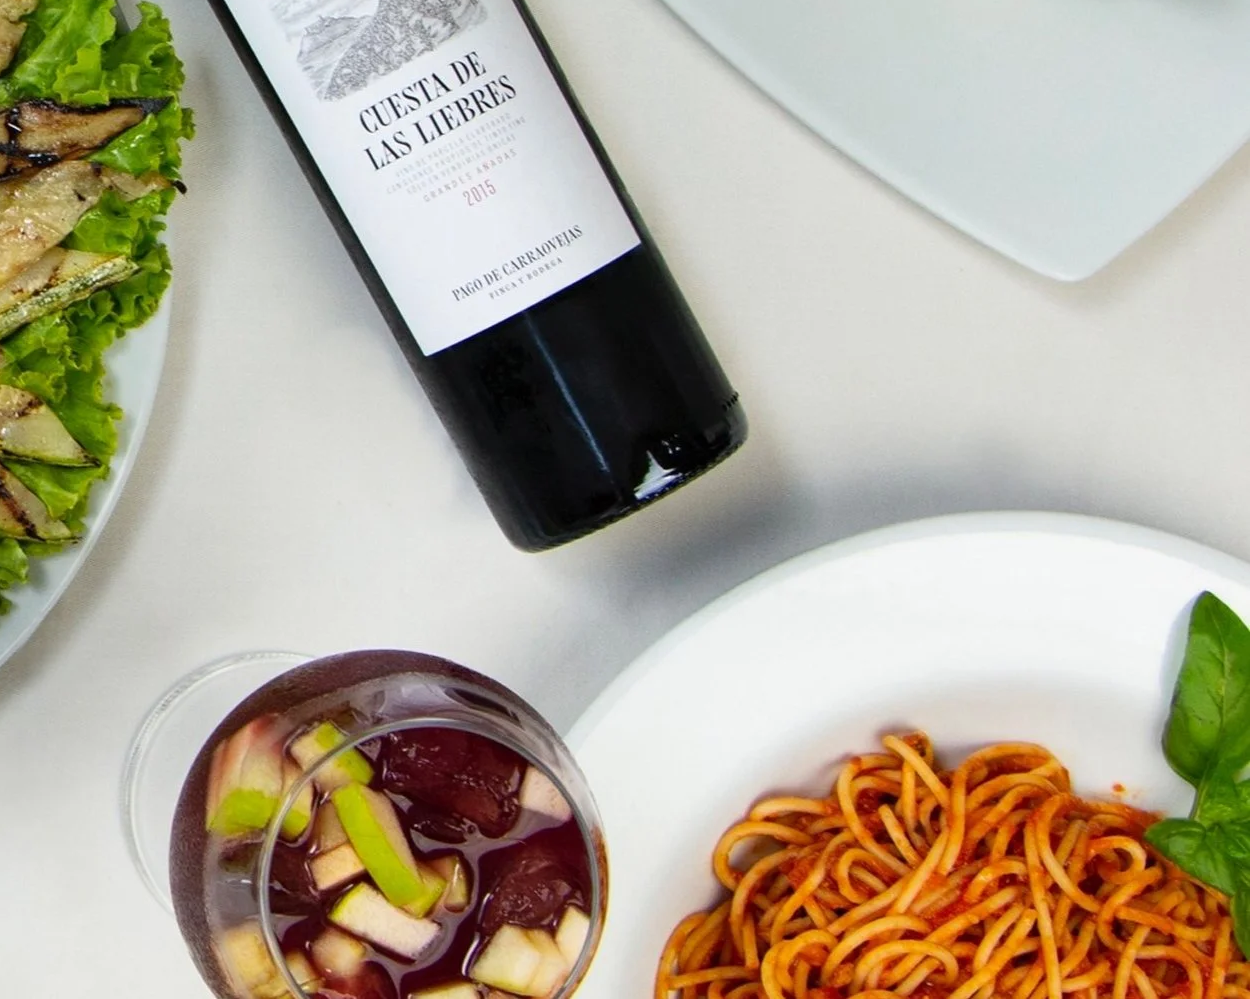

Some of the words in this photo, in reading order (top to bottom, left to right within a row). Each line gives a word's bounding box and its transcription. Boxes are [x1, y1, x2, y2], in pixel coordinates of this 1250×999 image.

[359, 73, 452, 134] CUESTA
[449, 51, 486, 86] DE
[364, 131, 412, 171] LAS
[413, 75, 517, 144] LIEBRES
[423, 172, 472, 202] GRANDES
[462, 179, 496, 206] 2015
[452, 278, 483, 301] PAGO
[483, 268, 502, 286] DE
[501, 224, 583, 276] CARRAOVEJAS
[489, 281, 517, 300] FINCA
[518, 276, 525, 284] Y
[526, 257, 563, 280] BODEGA
